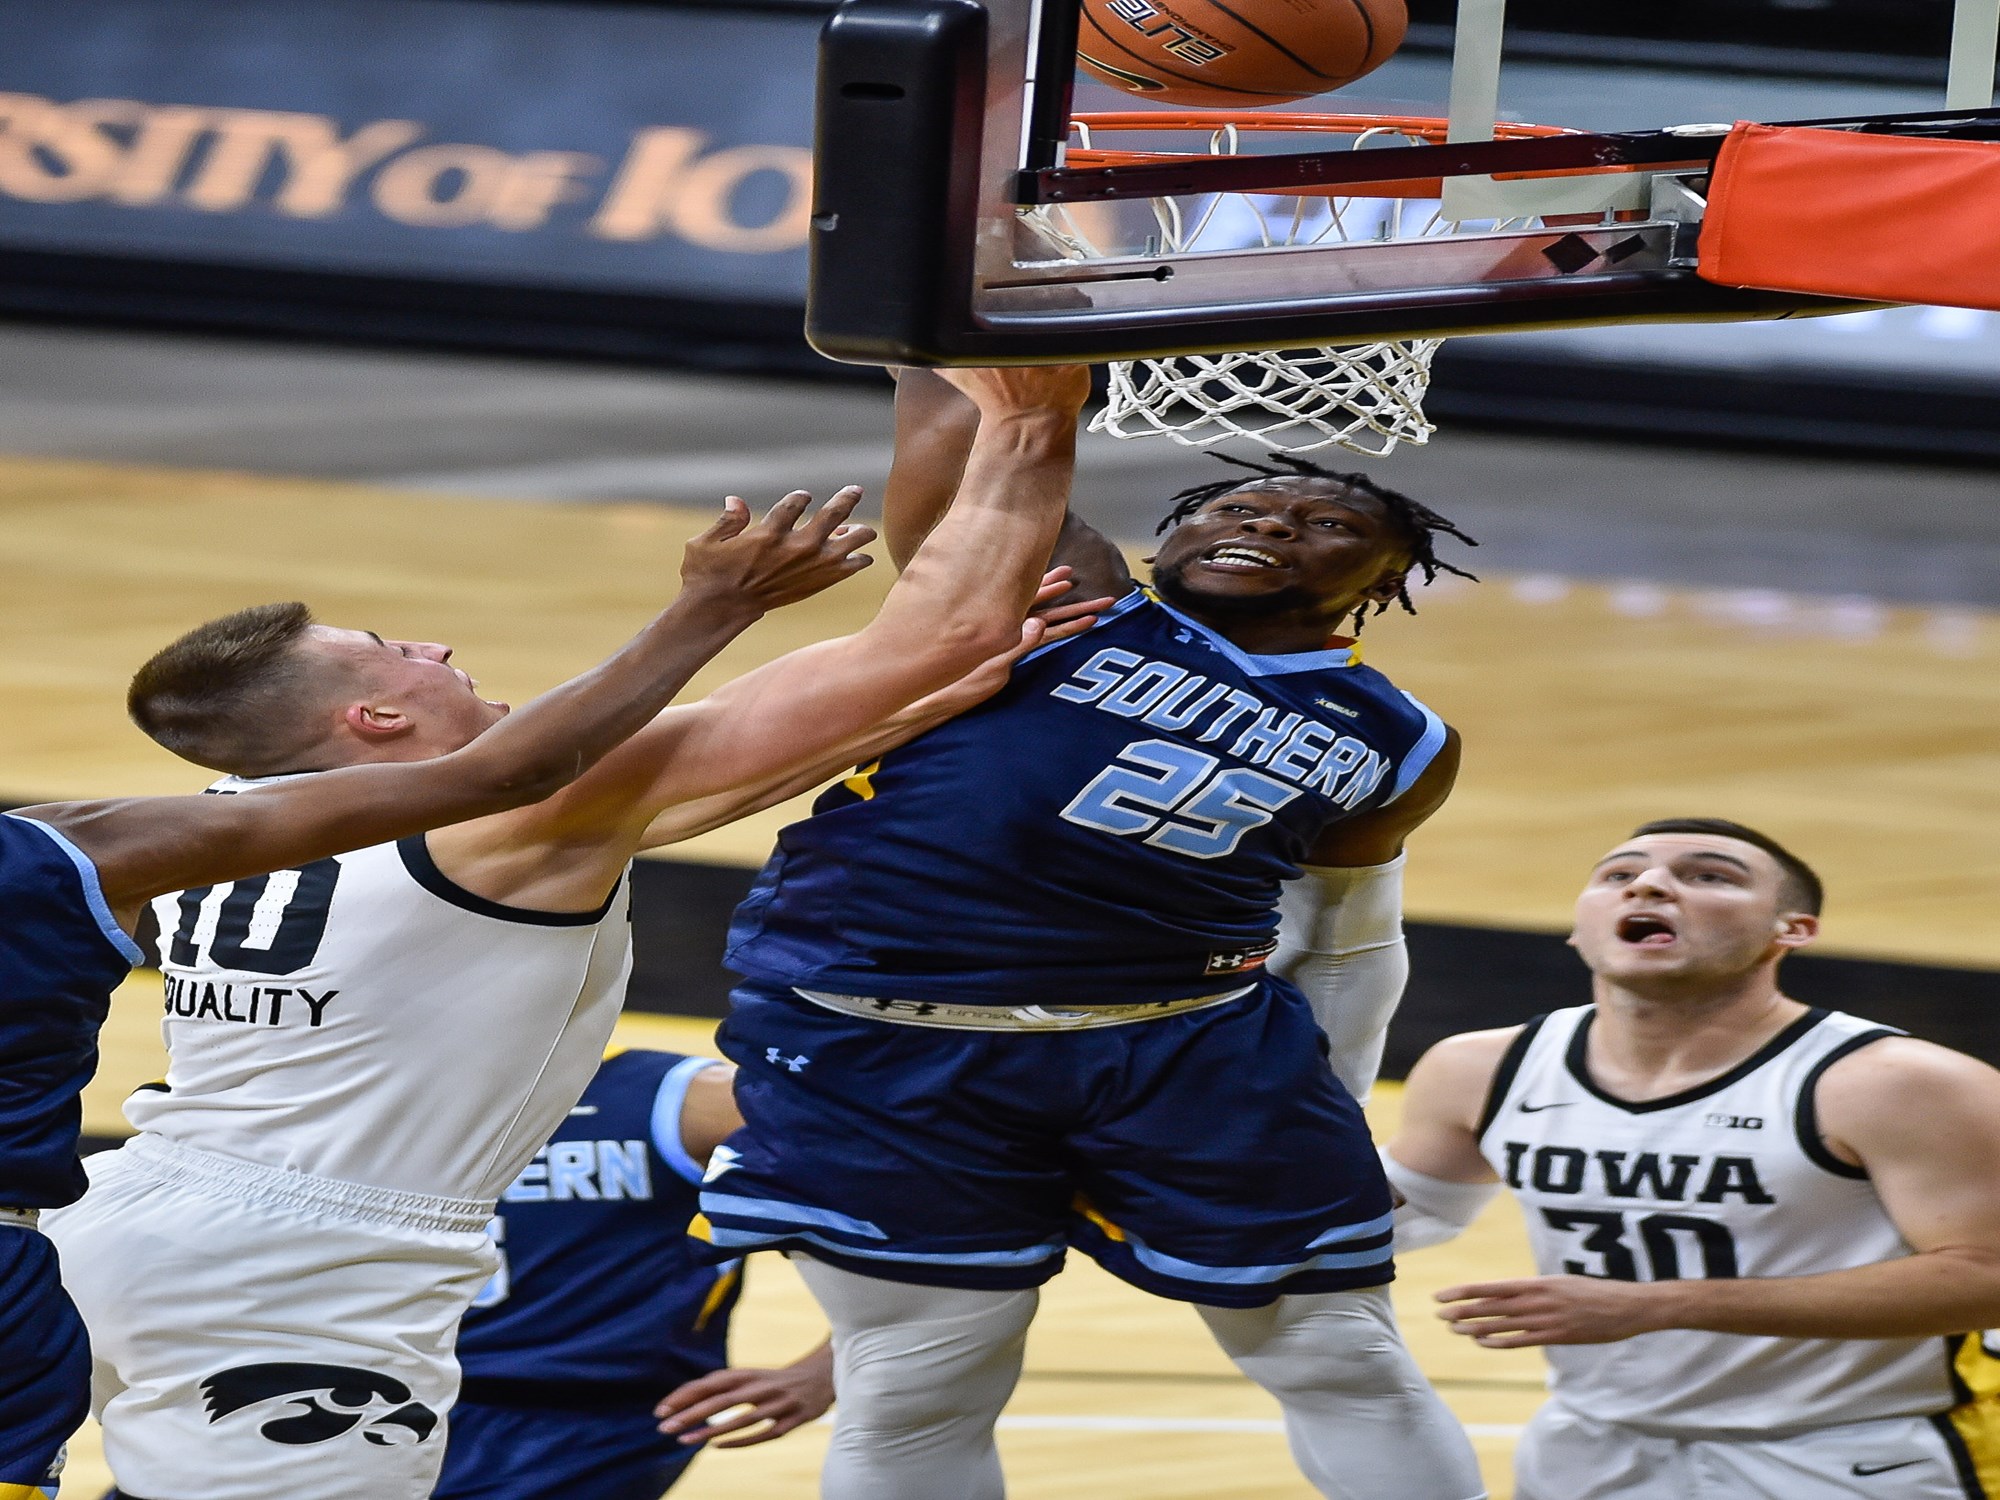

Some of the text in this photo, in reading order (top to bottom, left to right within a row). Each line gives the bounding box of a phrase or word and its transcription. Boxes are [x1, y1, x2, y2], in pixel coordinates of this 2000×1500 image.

[1105, 0, 1228, 66] ELITE
[1049, 647, 1392, 811] SOUTHERN
[1058, 738, 1304, 859] 25
[1504, 1141, 1776, 1204] IOWA
[1540, 1208, 1739, 1284] 30
